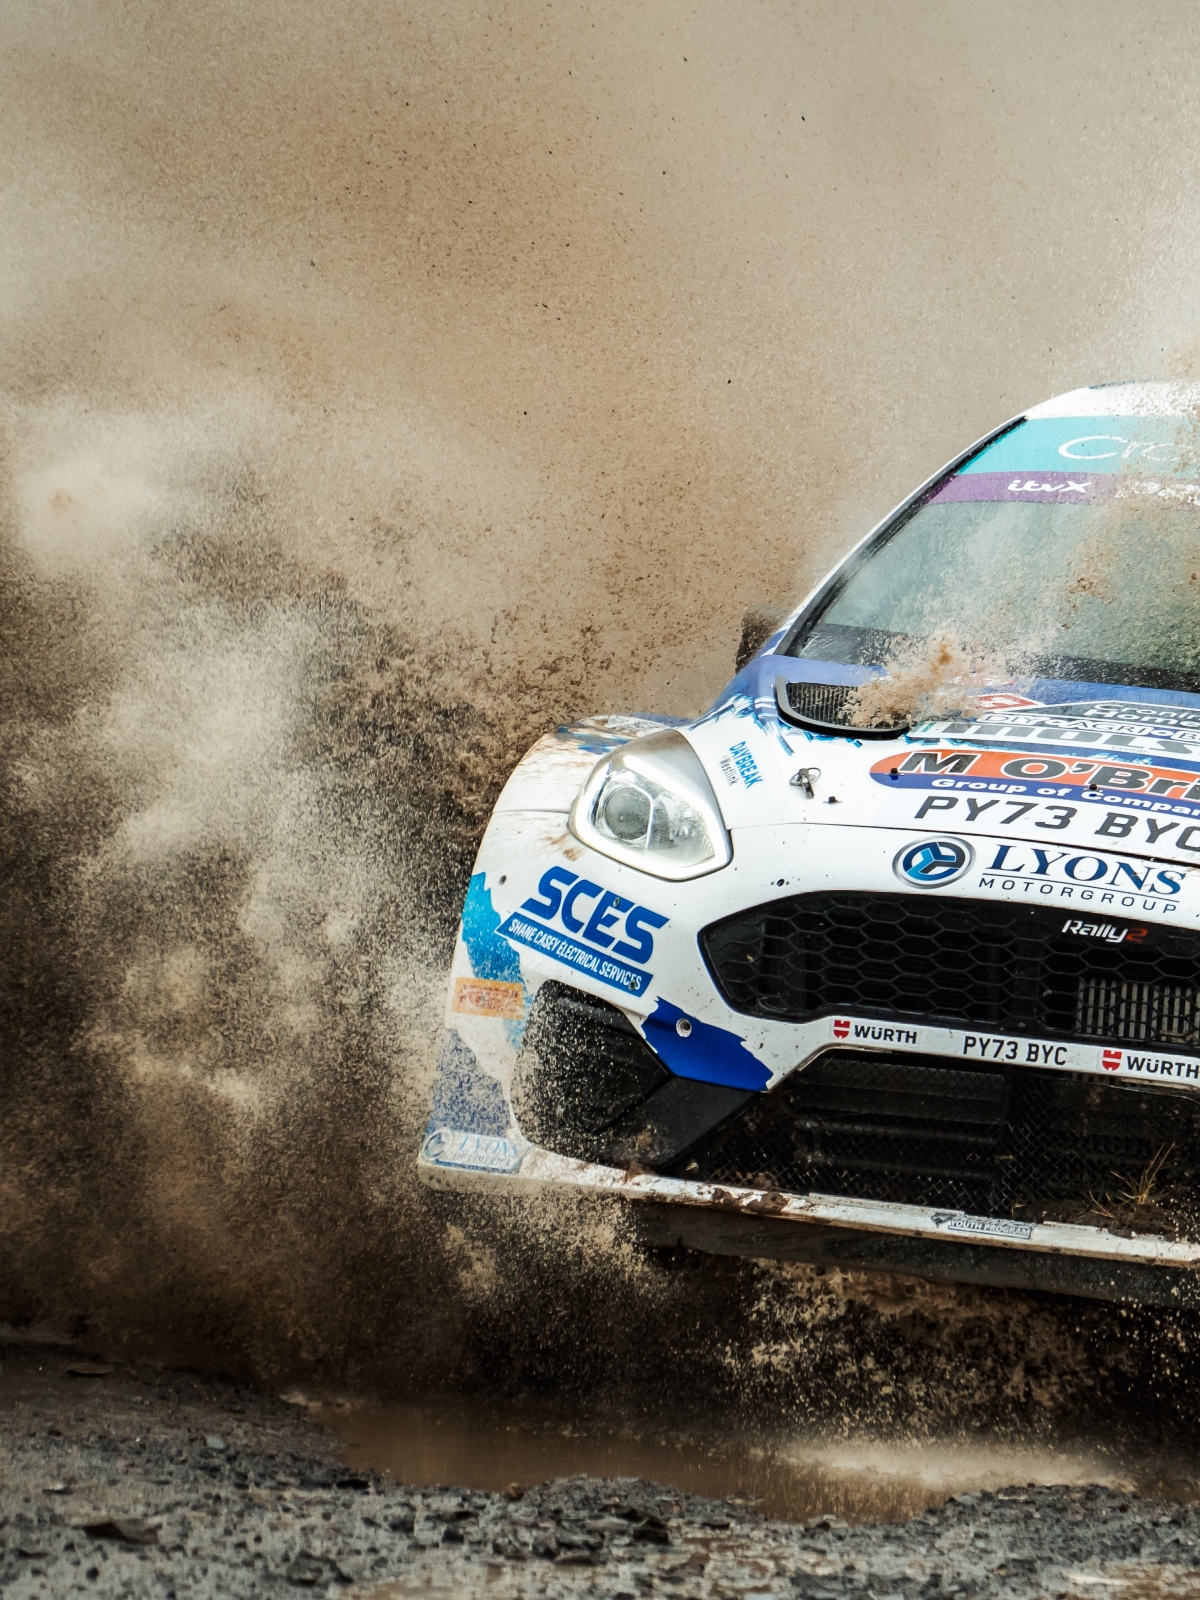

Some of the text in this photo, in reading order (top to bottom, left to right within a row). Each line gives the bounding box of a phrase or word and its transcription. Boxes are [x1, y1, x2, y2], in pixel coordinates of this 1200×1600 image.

[719, 755, 740, 786] Westlink
[729, 740, 763, 789] DAYBREAK
[898, 751, 982, 775] M
[931, 777, 1027, 796] Group
[1036, 786, 1074, 800] of
[914, 796, 1078, 830] PY73
[985, 844, 1187, 896] LYONS
[979, 878, 1181, 914] MOTORGROUP
[520, 865, 671, 964] SCES
[508, 918, 643, 990] SHANE CASEY ELECTRICAL SERVICES
[963, 1036, 1068, 1066] PY73 BYC
[950, 1219, 982, 1230] YOUTH
[983, 1224, 1031, 1236] PROGRAM
